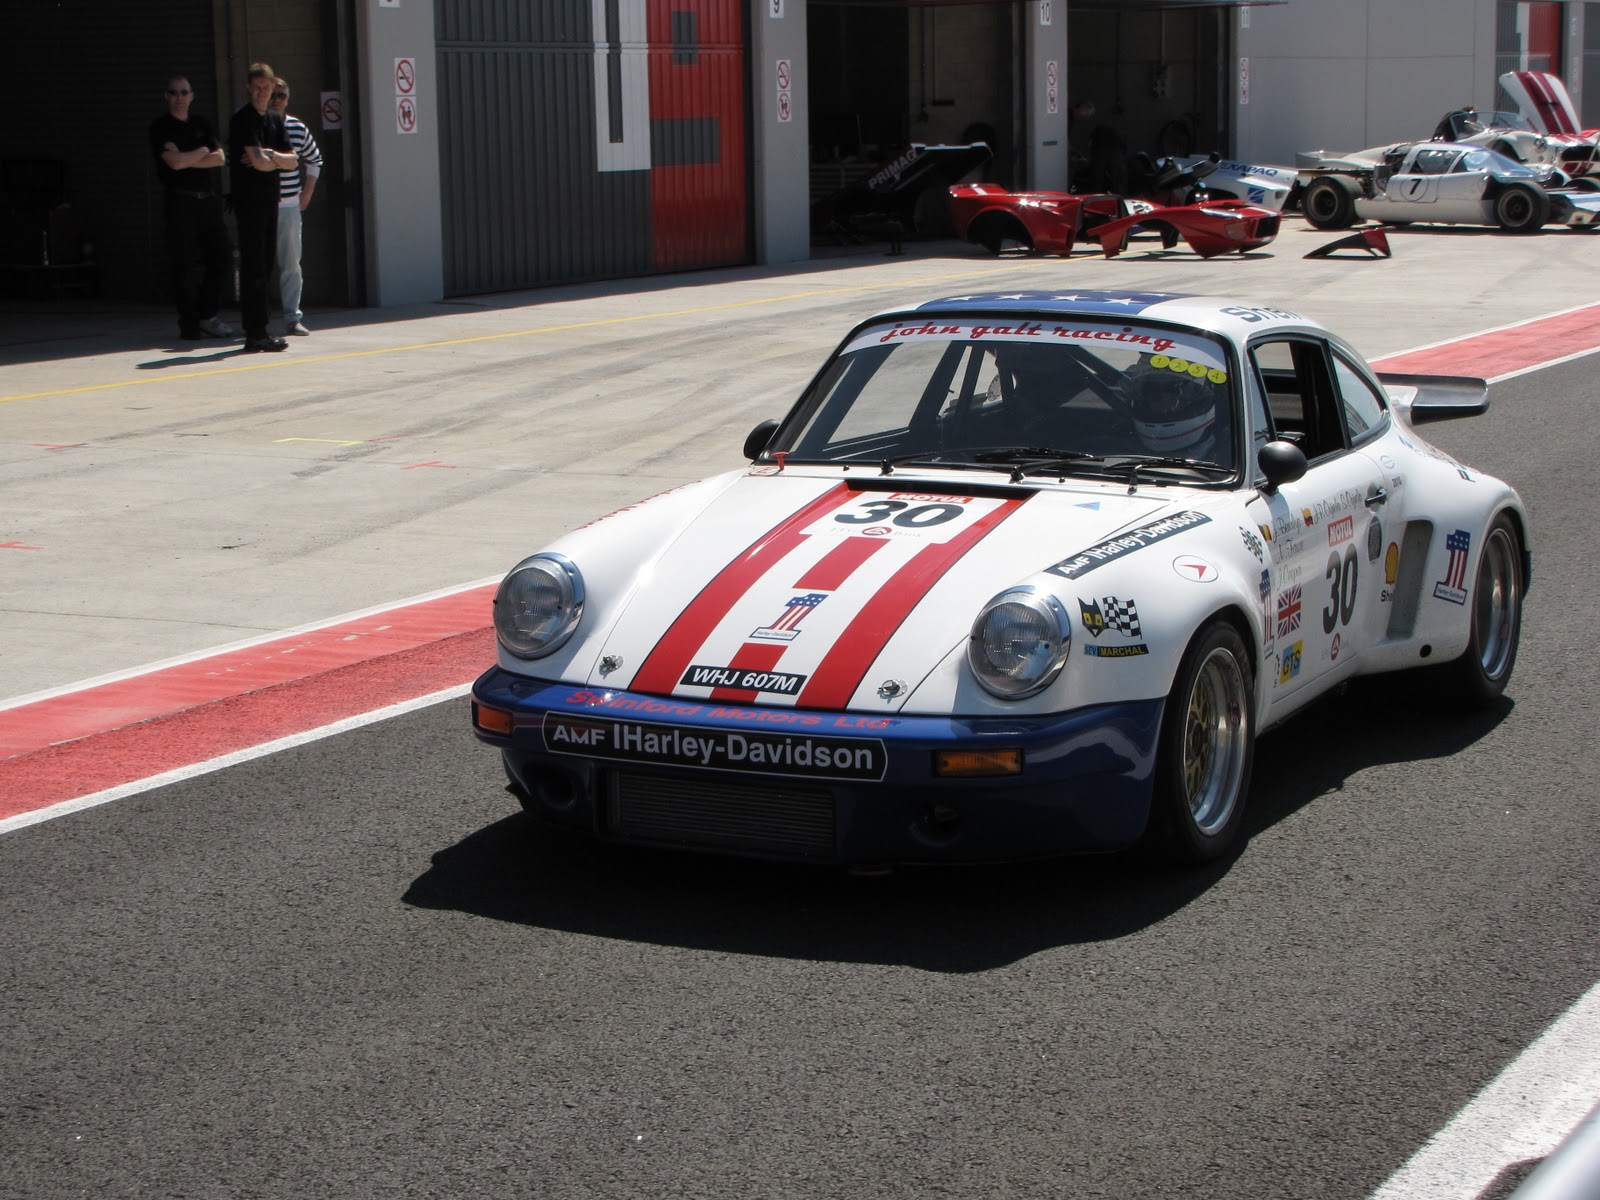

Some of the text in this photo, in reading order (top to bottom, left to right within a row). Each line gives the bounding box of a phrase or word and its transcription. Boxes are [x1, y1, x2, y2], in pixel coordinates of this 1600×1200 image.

[1041, 2, 1051, 22] 10
[1220, 162, 1278, 177] EXAPAQ
[1409, 178, 1422, 195] 7
[880, 322, 1176, 351] john galt racing
[891, 493, 967, 504] MOTUL
[834, 500, 965, 528] 30
[1329, 520, 1352, 544] MOTUL
[1058, 556, 1091, 575] AMF
[1323, 543, 1358, 635] 30
[1084, 645, 1145, 656] SEV MARCHAL
[1283, 650, 1301, 676] GTS
[692, 668, 798, 691] WHJ 607M
[566, 691, 893, 729] Swinford Motors Ltd
[553, 725, 606, 745] AMF
